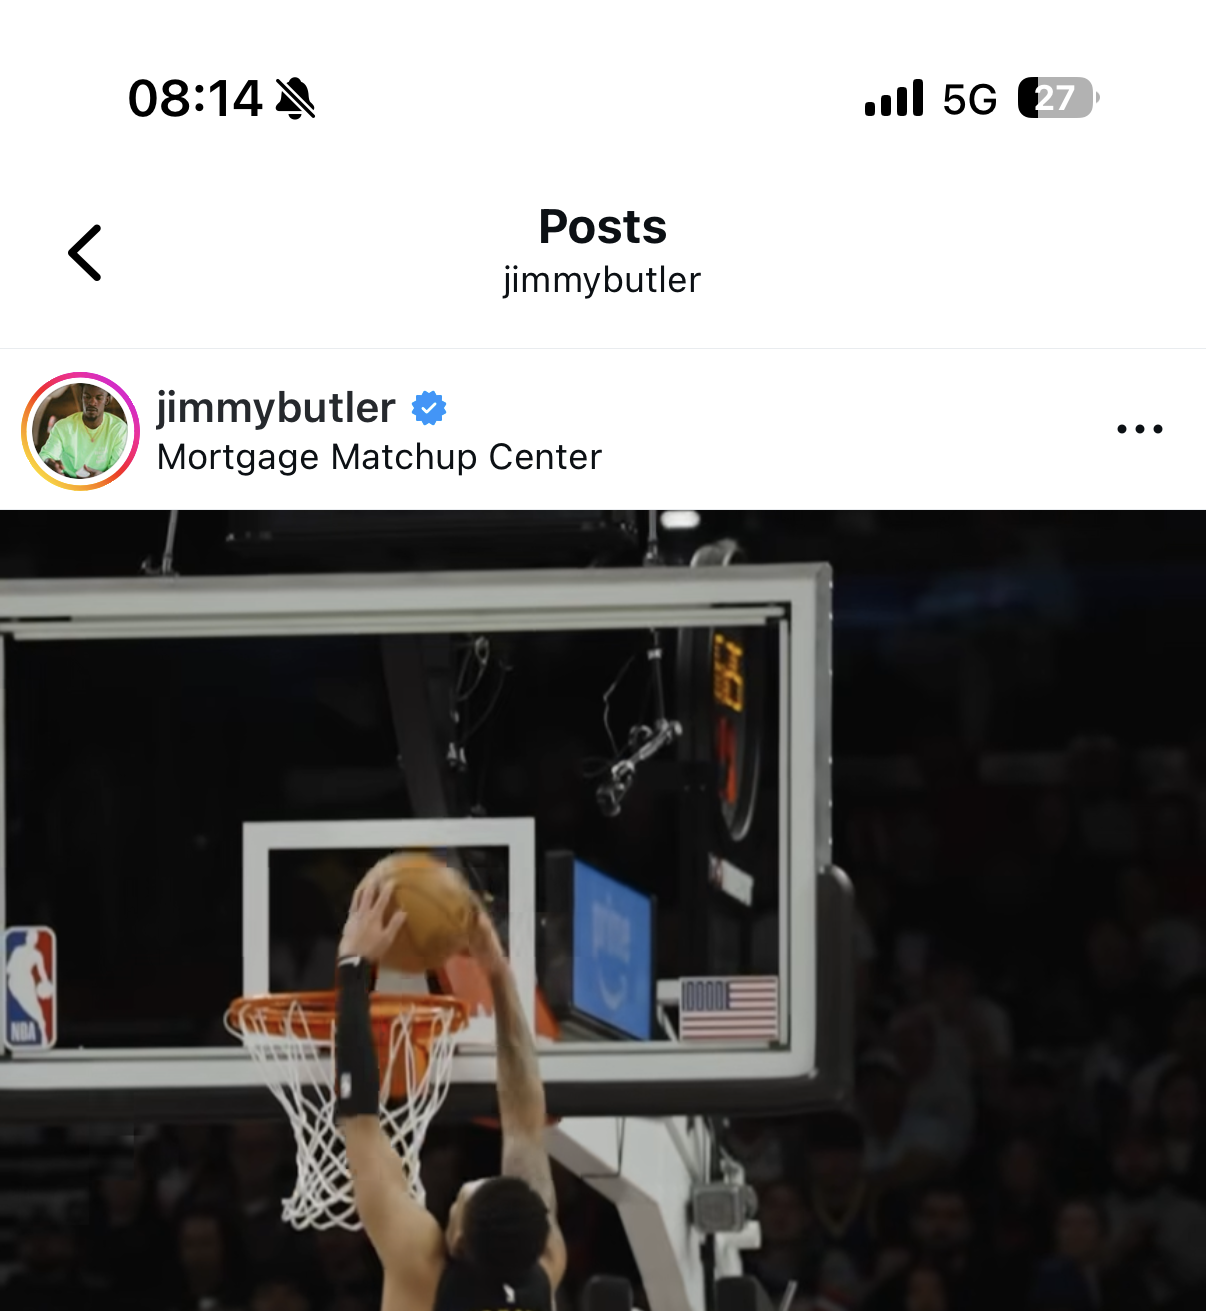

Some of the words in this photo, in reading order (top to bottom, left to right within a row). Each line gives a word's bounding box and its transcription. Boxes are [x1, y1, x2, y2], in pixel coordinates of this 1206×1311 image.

[129, 79, 263, 117] 08:14
[944, 82, 996, 116] 5G
[1035, 84, 1075, 111] 27
[541, 208, 666, 245] Posts
[502, 265, 701, 300] jimmybutler
[156, 390, 396, 430] jimmybutler
[158, 443, 318, 477] Mortgage
[333, 442, 476, 477] Matchup
[490, 443, 603, 471] Center
[11, 1021, 37, 1042] NBA
